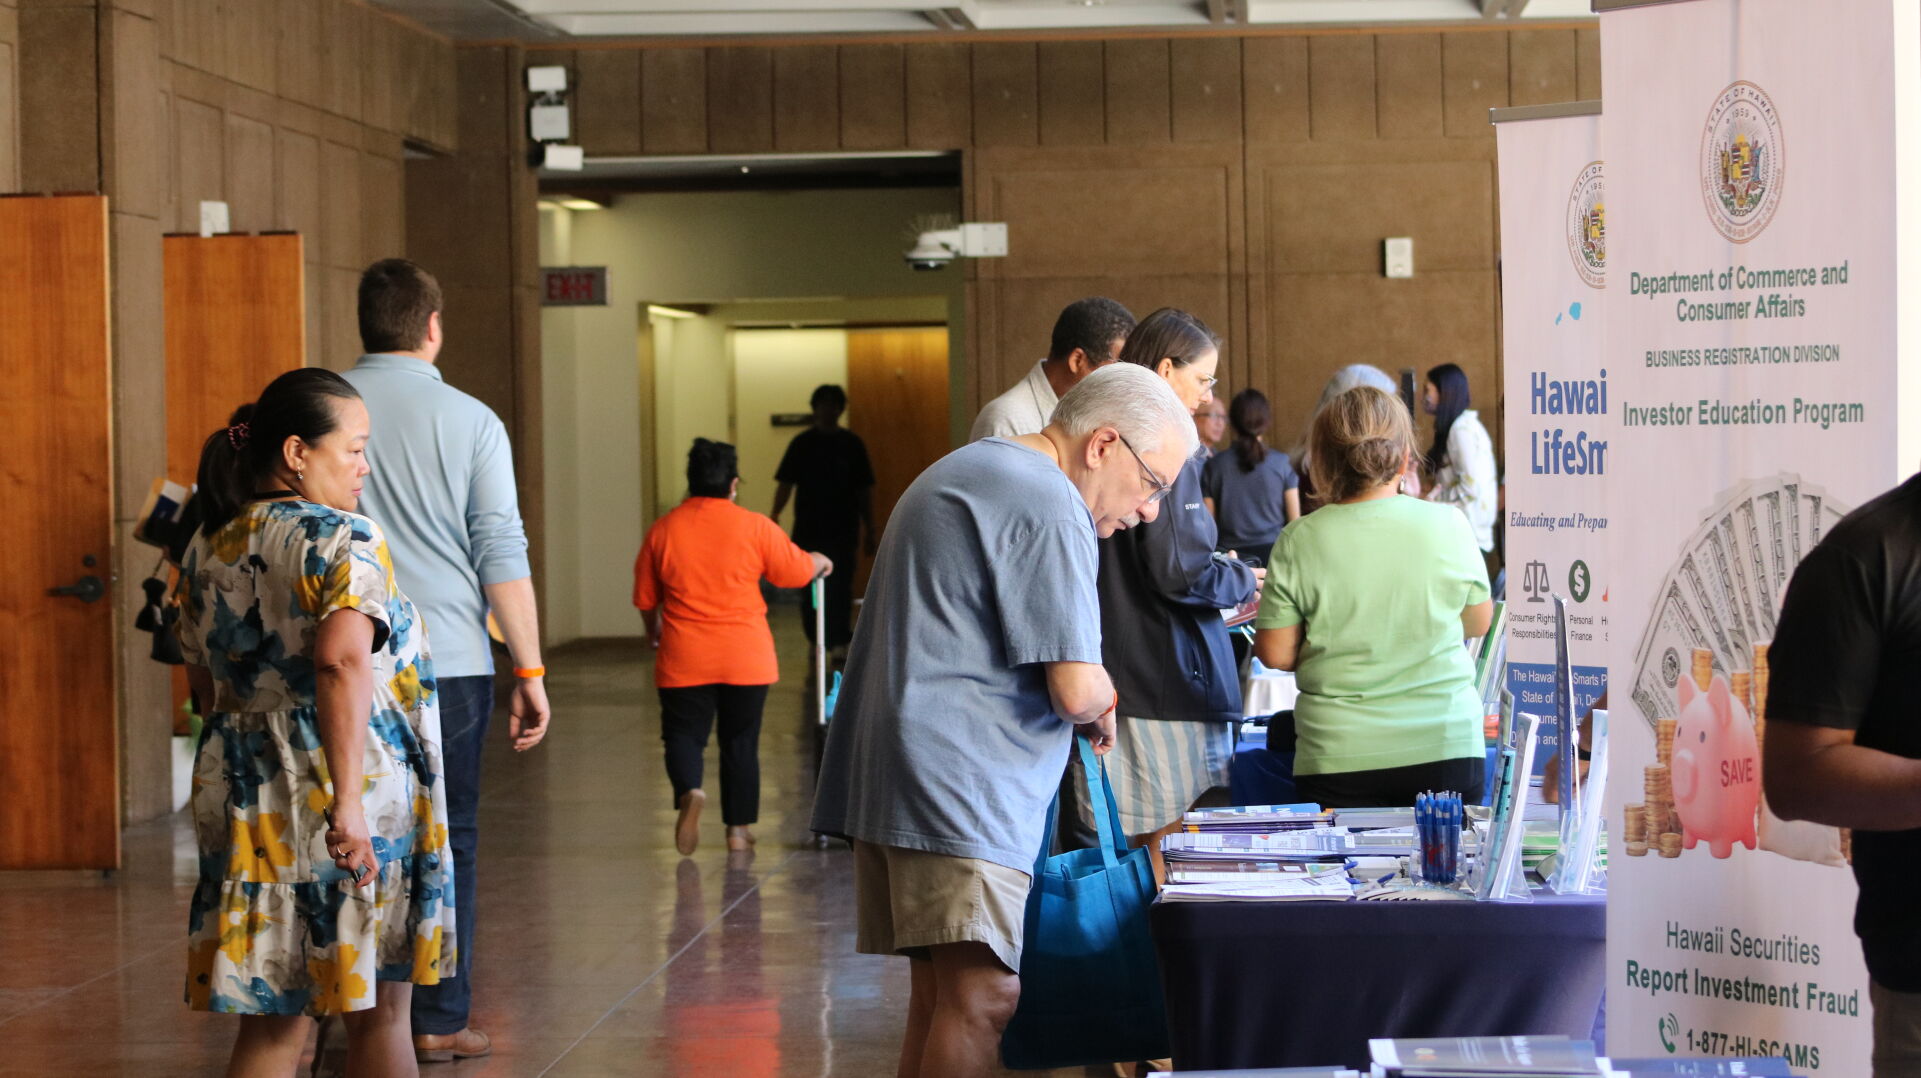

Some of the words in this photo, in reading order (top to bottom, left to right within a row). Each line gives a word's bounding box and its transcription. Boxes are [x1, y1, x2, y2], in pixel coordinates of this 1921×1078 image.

[547, 273, 596, 300] EXIT
[1630, 269, 1714, 300] Department
[1719, 266, 1733, 290] of
[1736, 265, 1816, 290] Commerce
[1821, 260, 1848, 285] and
[1676, 298, 1752, 322] Consumer
[1754, 293, 1806, 319] Affairs
[1645, 350, 1701, 368] BUSINESS
[1704, 345, 1790, 366] REGISTRATION
[1793, 344, 1840, 363] DIVISION
[1623, 401, 1693, 427] Investor
[1698, 398, 1786, 425] Education
[1793, 397, 1865, 430] Program
[1510, 511, 1556, 532] Educating
[1558, 512, 1576, 528] and
[1508, 611, 1536, 623] Consumer
[1569, 614, 1594, 626] Personal
[1570, 630, 1593, 641] Finance
[1513, 669, 1528, 682] The
[1521, 690, 1543, 704] State
[1544, 691, 1555, 704] of
[1720, 757, 1753, 788] SAVE
[1667, 920, 1724, 954] Hawaii
[1730, 927, 1821, 966] Securities
[1626, 959, 1689, 997] Report
[1694, 968, 1799, 1009] Investment
[1807, 982, 1859, 1017] Fraud
[1686, 1028, 1821, 1070] 1-877-HI-SCAMS
